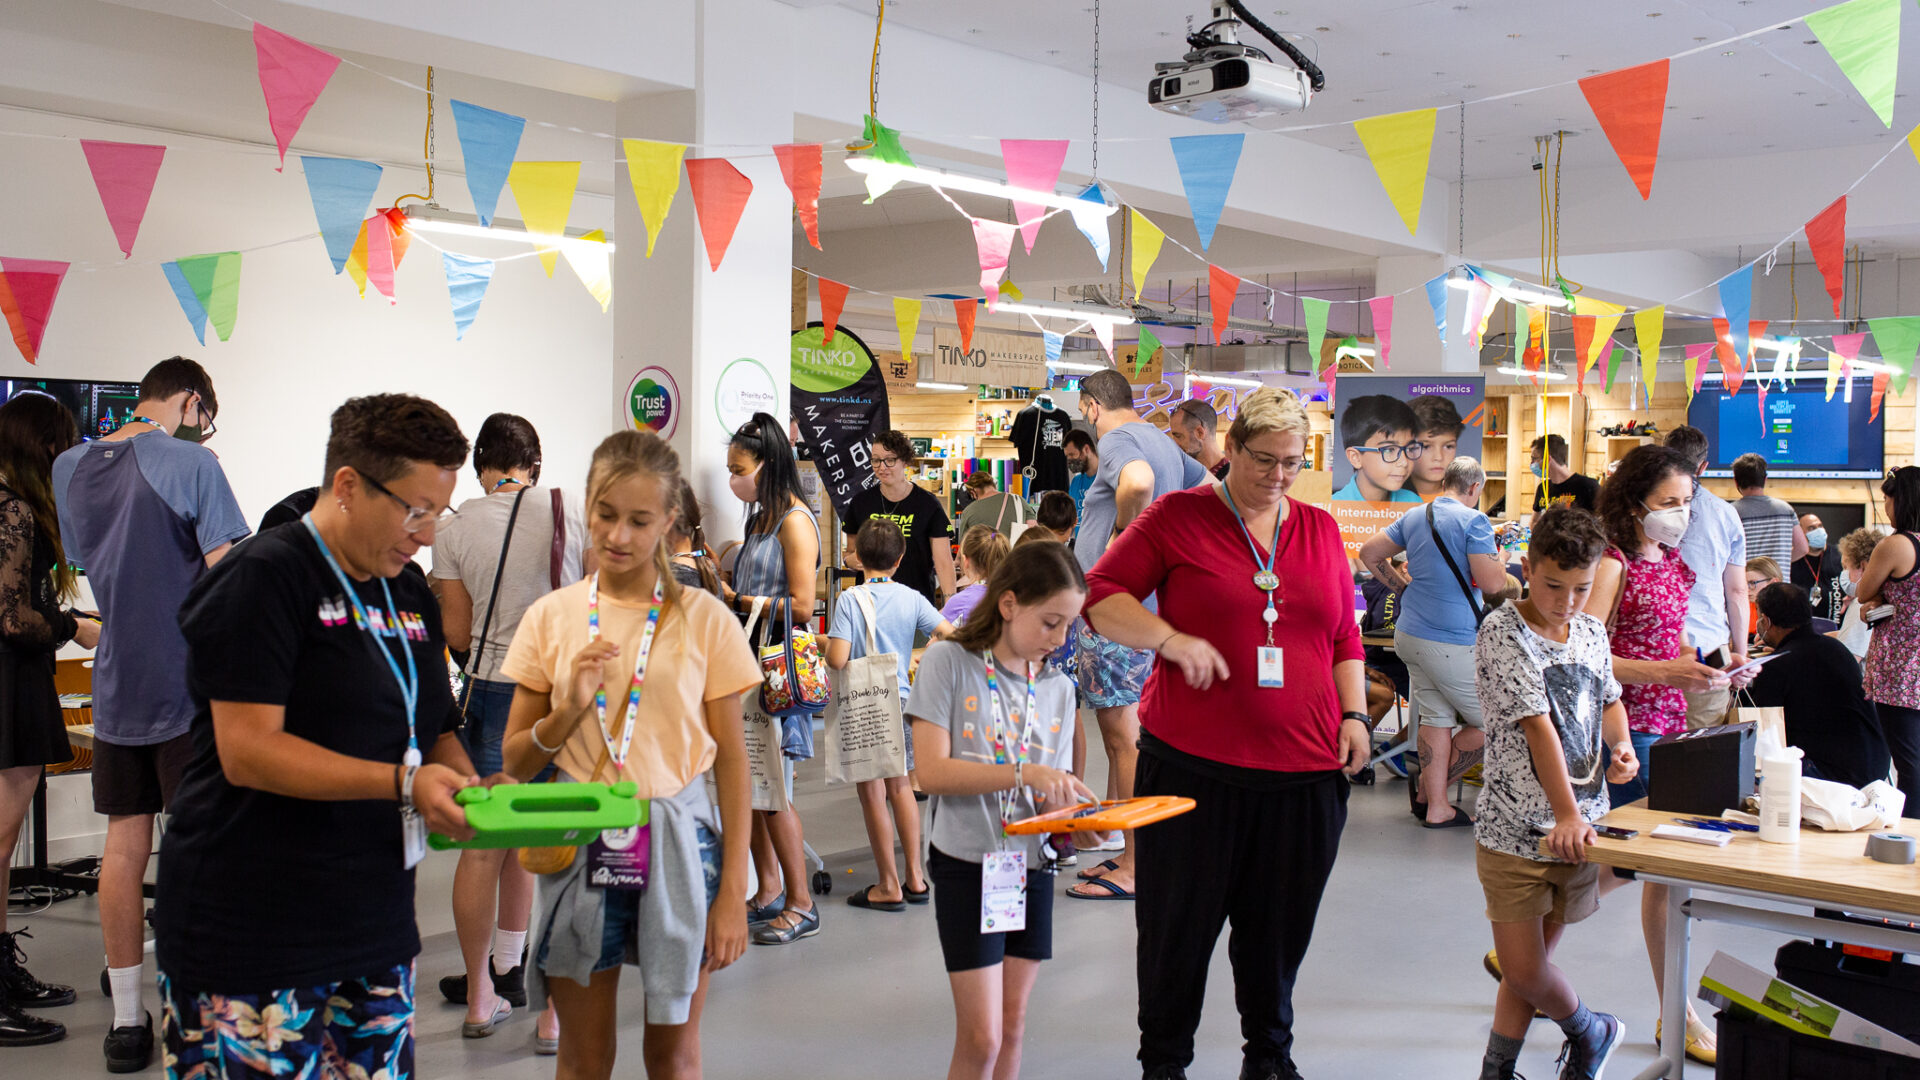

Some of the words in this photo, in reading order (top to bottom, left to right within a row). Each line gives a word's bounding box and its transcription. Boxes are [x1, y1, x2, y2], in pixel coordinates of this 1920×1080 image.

[797, 347, 856, 367] TINKD
[938, 344, 987, 368] TINKD
[990, 351, 1044, 362] MAKERSPACE
[741, 391, 761, 400] Priority
[762, 392, 774, 400] One
[1412, 384, 1471, 395] algorithmics
[634, 394, 666, 410] Trust
[645, 410, 665, 419] power
[1043, 431, 1064, 442] STEM
[804, 404, 852, 505] MAKERS
[1337, 507, 1405, 519] Internation
[1337, 523, 1376, 534] School
[1383, 592, 1397, 621] SALTY
[872, 685, 890, 699] Bag
[752, 711, 770, 728] Bag
